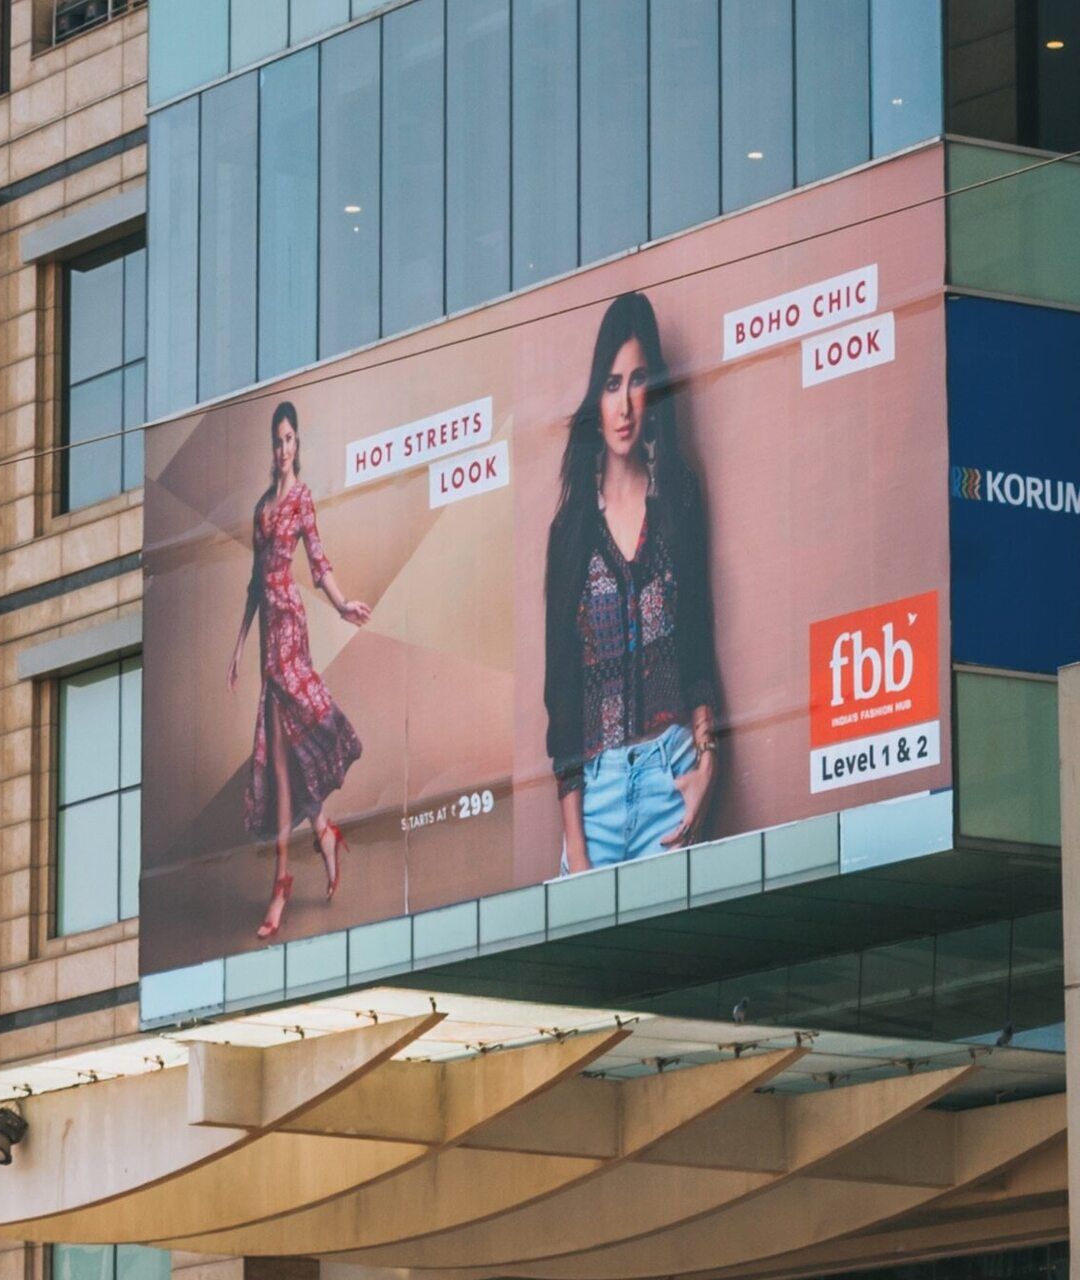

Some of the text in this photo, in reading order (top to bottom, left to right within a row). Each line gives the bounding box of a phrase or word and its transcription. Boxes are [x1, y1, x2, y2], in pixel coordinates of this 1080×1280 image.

[735, 280, 866, 345] BOHO CHIC
[815, 329, 881, 371] LOOK
[355, 412, 482, 473] HOT STREETS
[440, 455, 497, 493] LOOK
[829, 621, 914, 707] fbb
[860, 704, 894, 720] FASHION
[895, 698, 912, 713] HUB
[822, 735, 928, 781] Level 1 & 2
[400, 810, 435, 831] STARTS
[436, 806, 447, 822] AT
